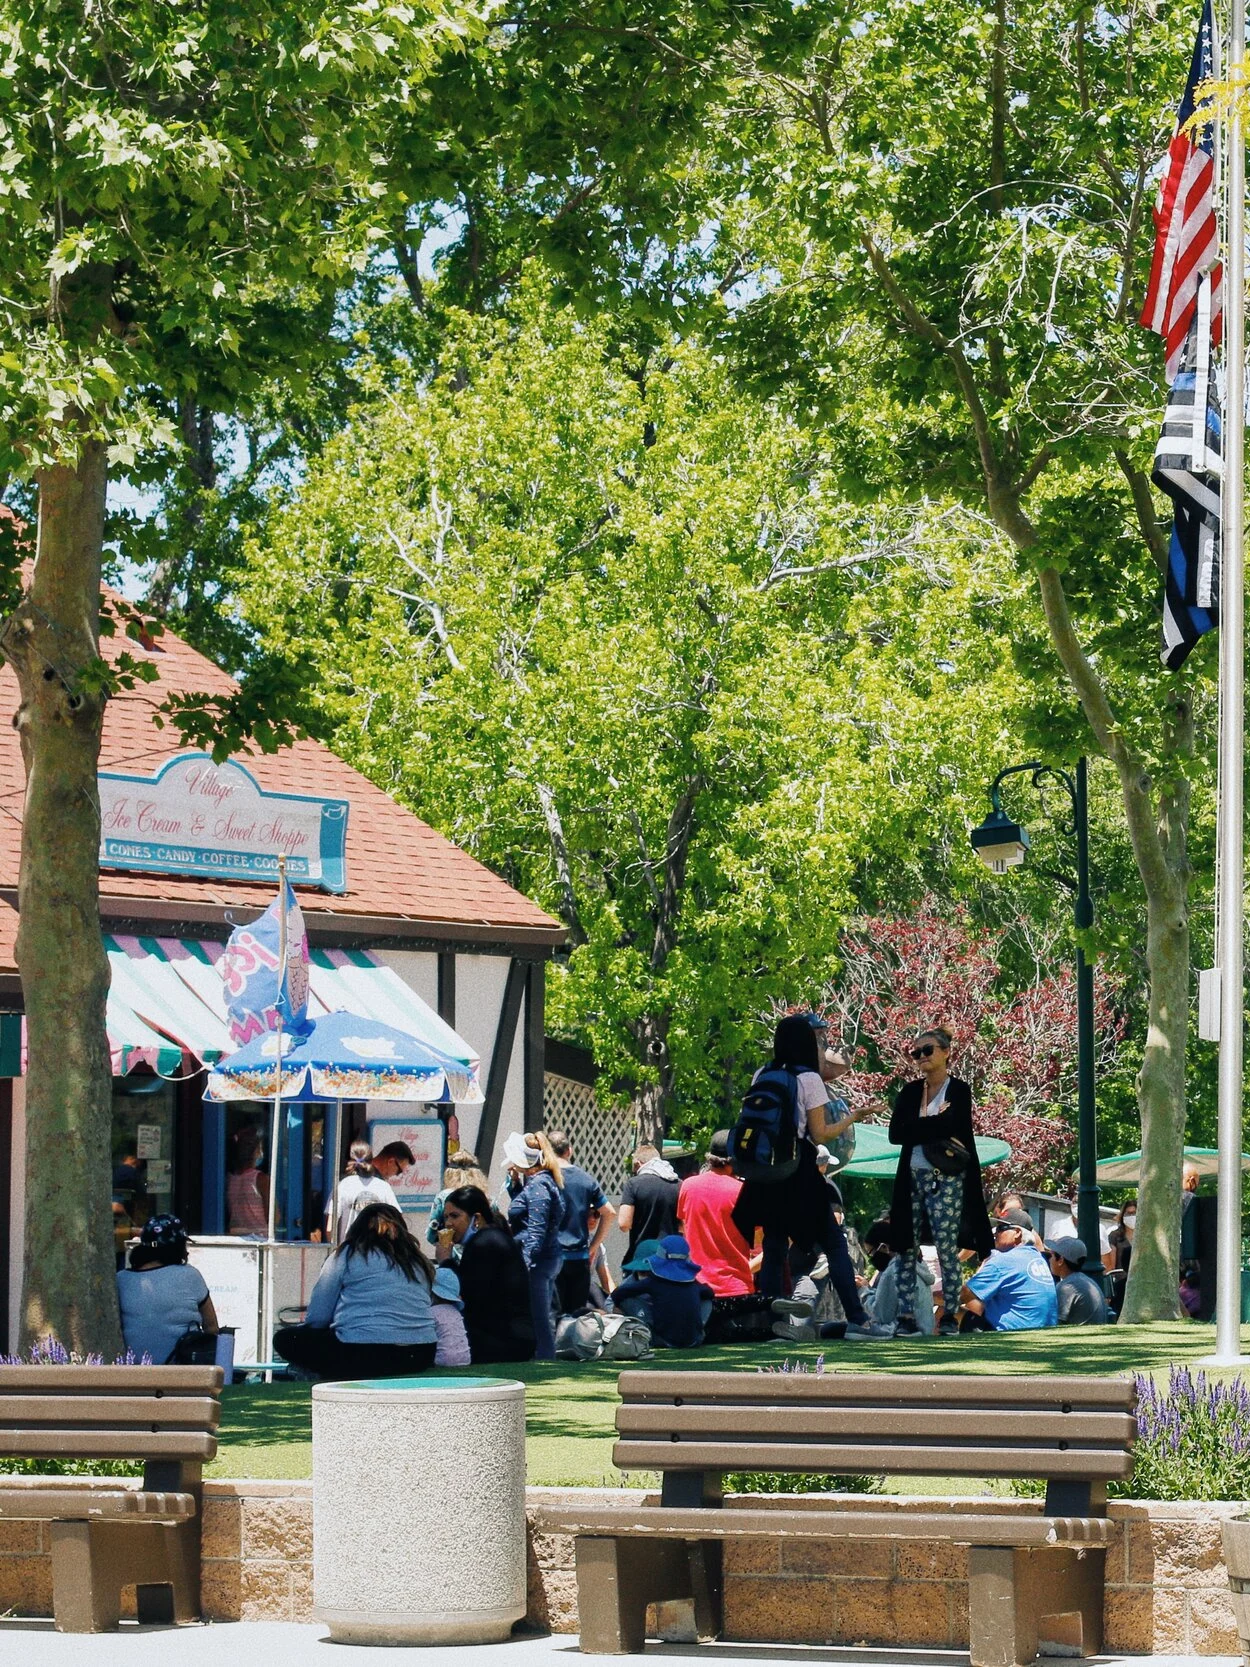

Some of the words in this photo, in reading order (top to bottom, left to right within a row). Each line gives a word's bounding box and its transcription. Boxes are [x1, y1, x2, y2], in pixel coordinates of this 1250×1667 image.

[185, 765, 235, 808] Village
[103, 798, 131, 830] Ice
[136, 800, 181, 835] Cream
[190, 812, 205, 836] &
[212, 811, 256, 842] Sweet
[259, 815, 310, 856] Shoppe
[109, 843, 151, 859] CONES
[157, 847, 196, 864] CANDY
[202, 852, 249, 868] COFFEE
[253, 857, 306, 872] COOIES
